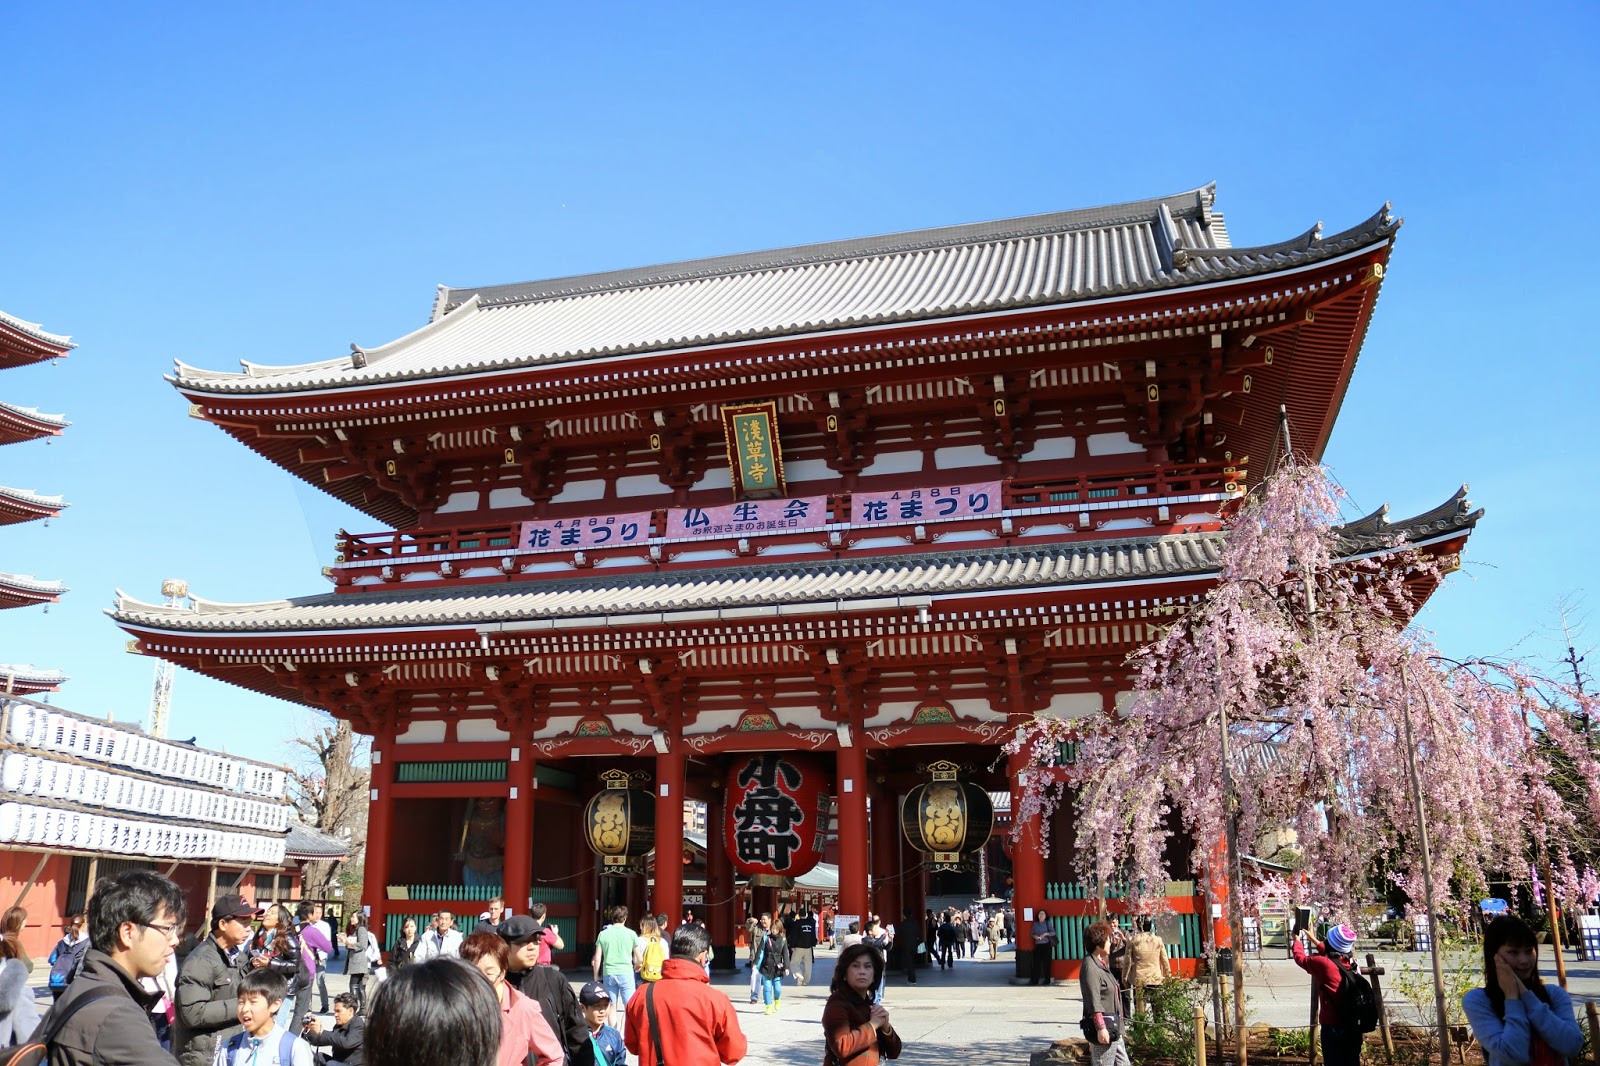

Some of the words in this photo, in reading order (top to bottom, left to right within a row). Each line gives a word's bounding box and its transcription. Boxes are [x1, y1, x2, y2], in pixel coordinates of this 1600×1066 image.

[890, 487, 961, 500] 4月8日
[682, 500, 810, 528] 仏生会
[862, 493, 989, 522] 花まつり
[528, 522, 638, 548] 花まつり
[554, 517, 616, 529] 4月8日
[692, 519, 798, 536] お釈迦さまのお誕生日
[733, 754, 804, 871] 小舟町
